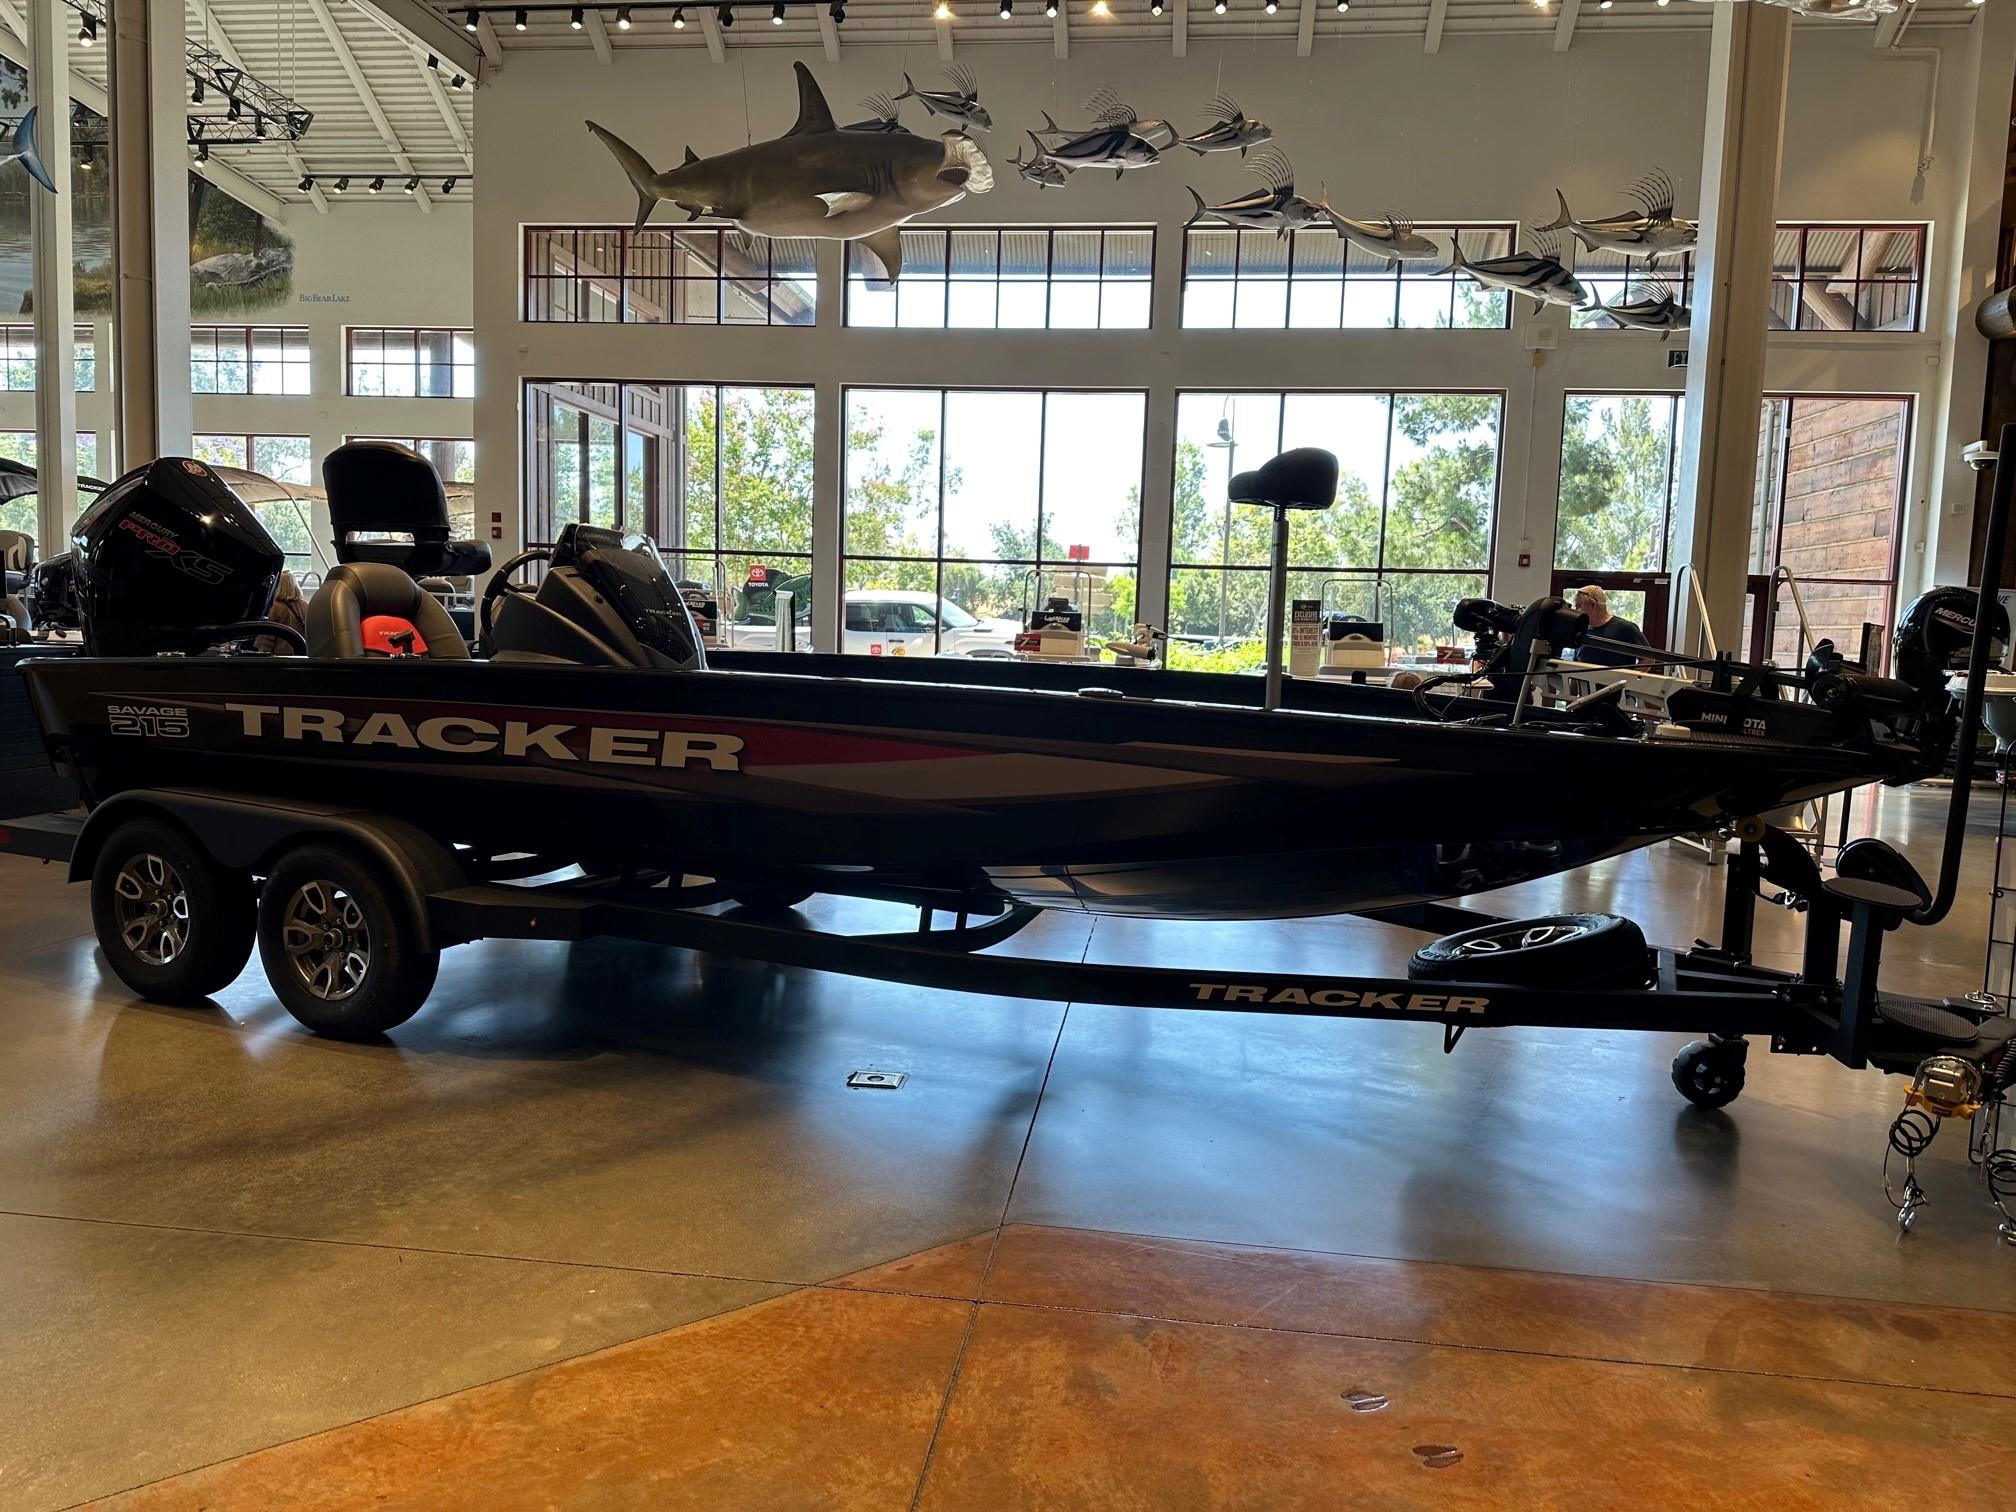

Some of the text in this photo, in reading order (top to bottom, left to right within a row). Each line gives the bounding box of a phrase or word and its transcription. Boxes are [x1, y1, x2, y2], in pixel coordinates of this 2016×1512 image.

[118, 519, 181, 555] PRO
[129, 511, 179, 538] MERCURY
[645, 608, 682, 616] TRACKER
[1935, 607, 1977, 627] MERCU
[107, 705, 188, 717] SAVAGE
[109, 714, 190, 738] 215
[225, 703, 745, 771] TRACKER
[1189, 983, 1490, 1014] TRACKER
